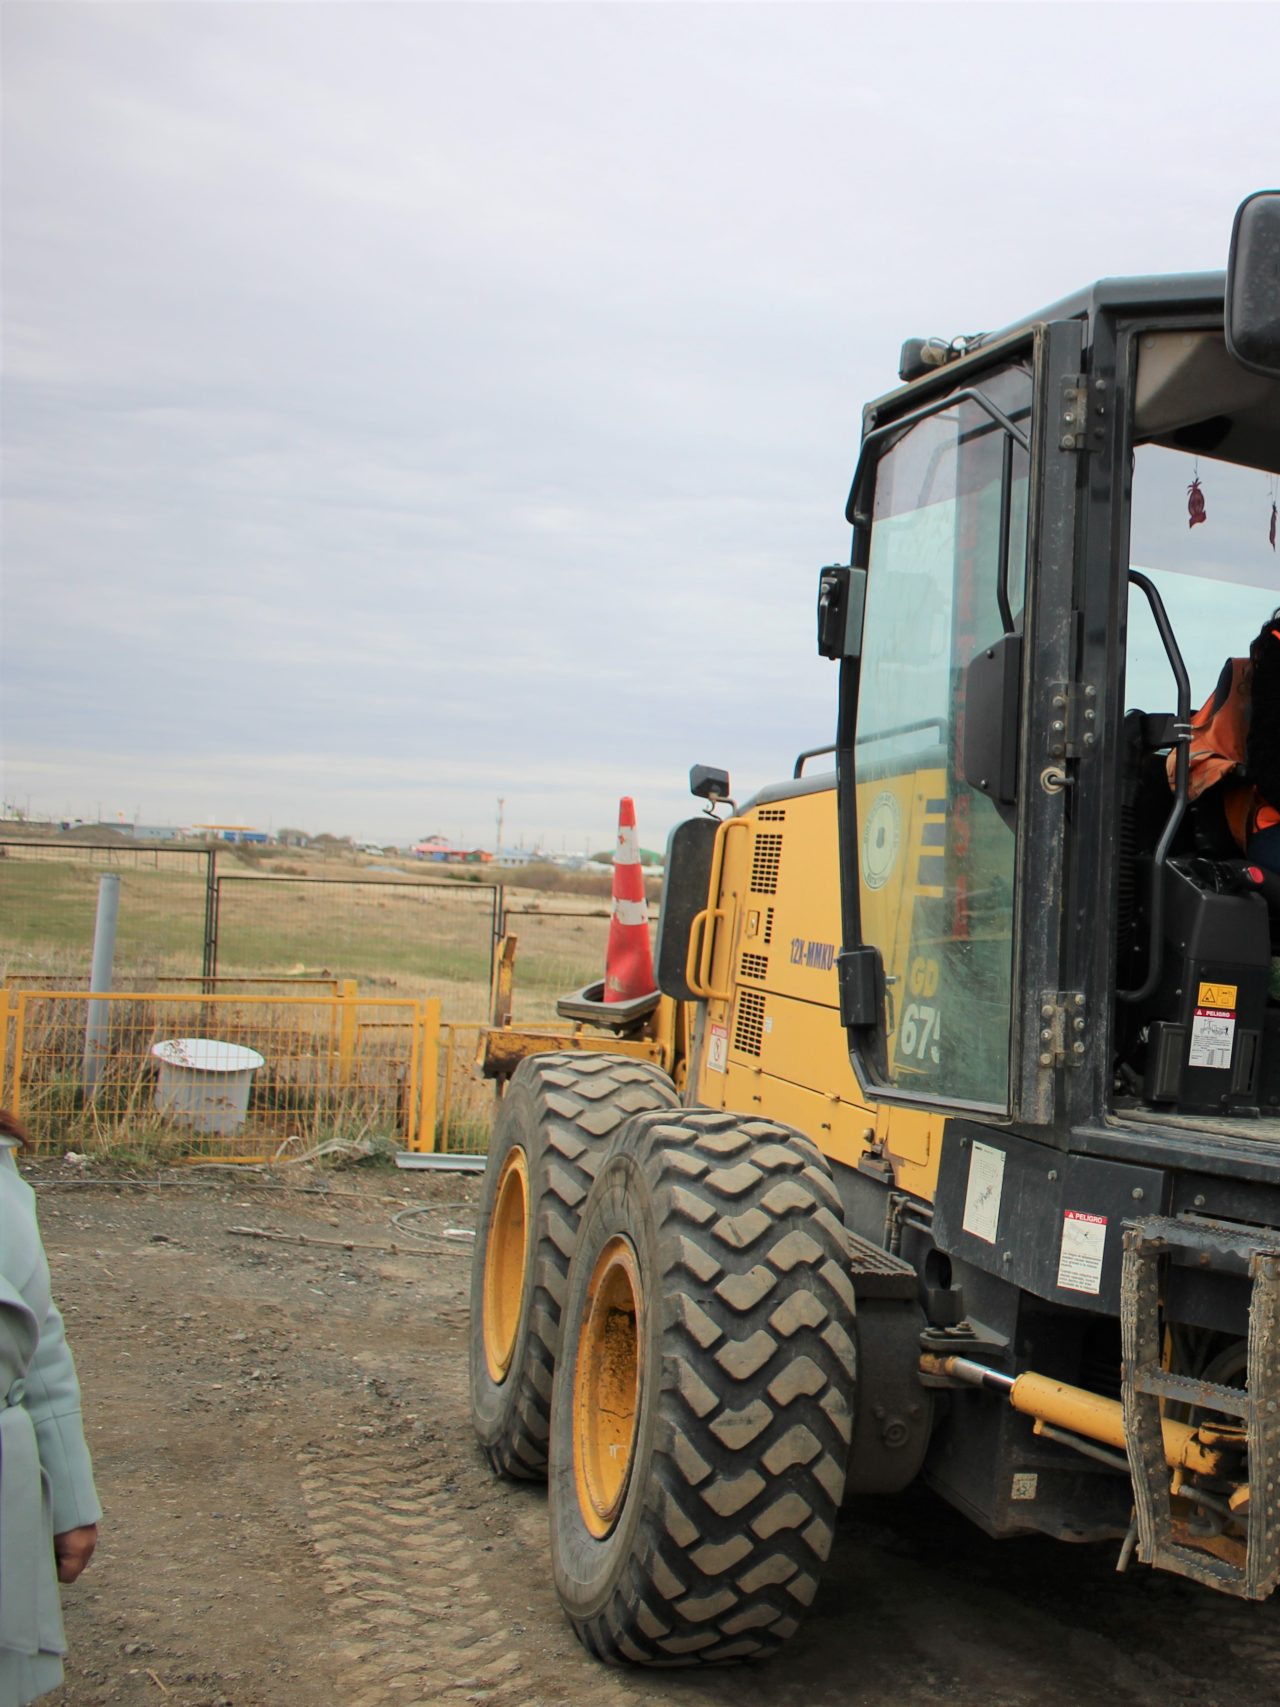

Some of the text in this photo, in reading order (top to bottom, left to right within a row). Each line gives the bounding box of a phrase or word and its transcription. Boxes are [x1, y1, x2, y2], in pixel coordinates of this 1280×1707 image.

[911, 956, 939, 998] GD
[1205, 1010, 1231, 1018] PELIGRO
[1075, 1213, 1103, 1224] PELIGRO
